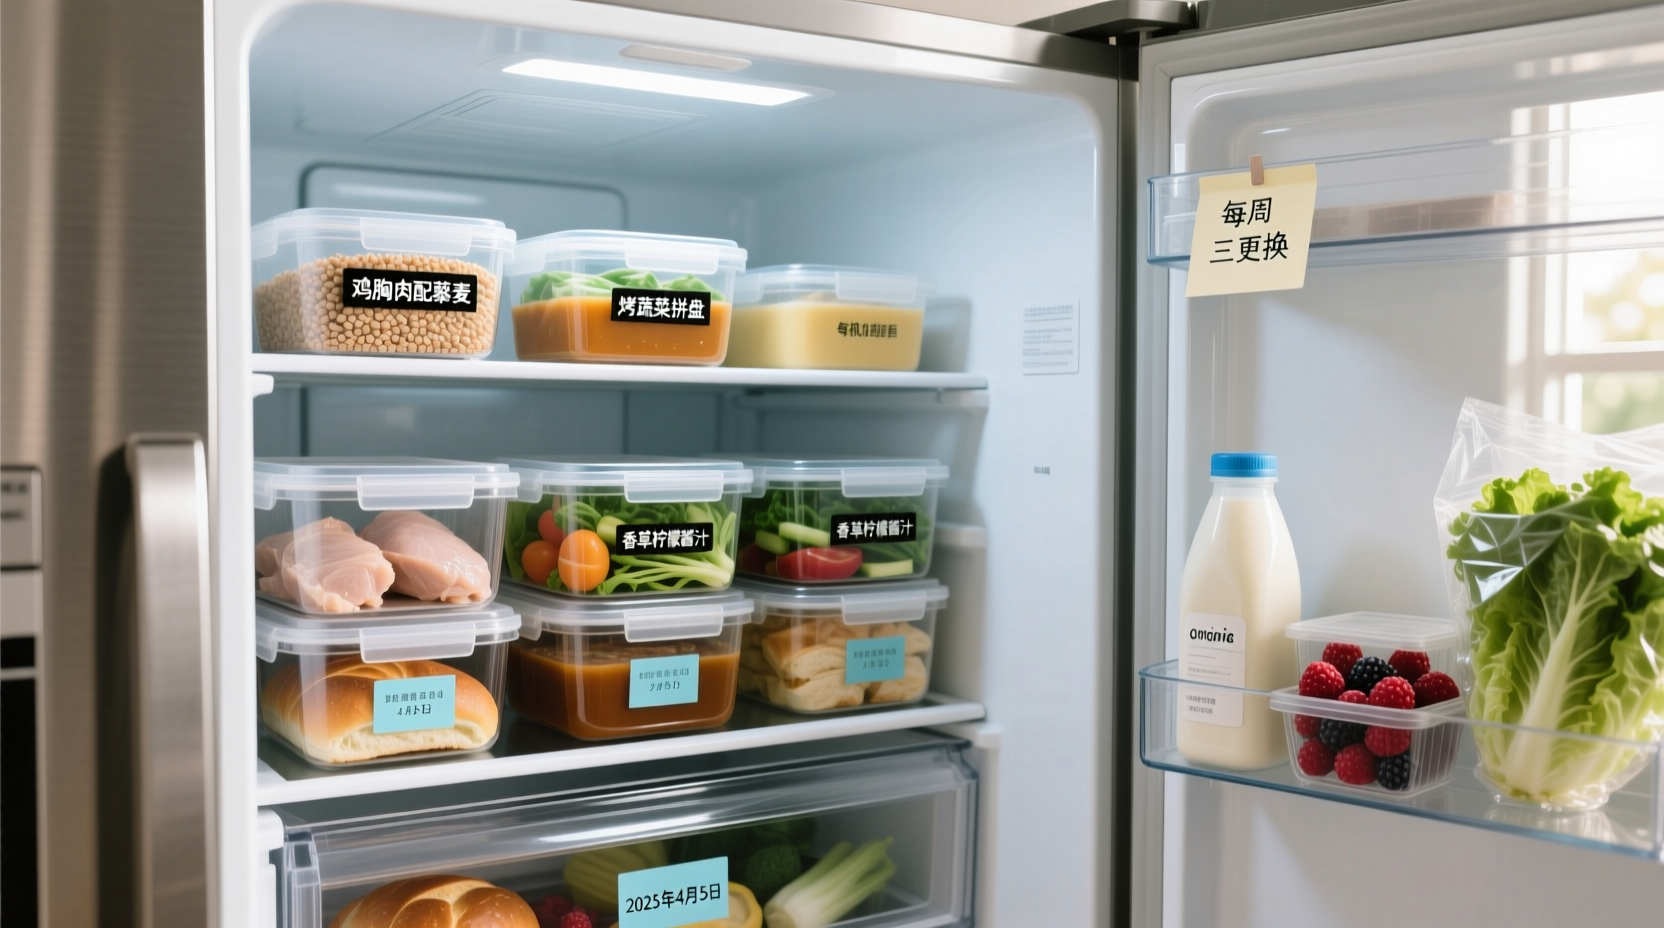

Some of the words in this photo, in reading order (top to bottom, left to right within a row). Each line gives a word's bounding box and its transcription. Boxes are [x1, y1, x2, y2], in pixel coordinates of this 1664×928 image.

[1221, 196, 1272, 228] 每周
[1209, 230, 1289, 263] 三更换
[617, 295, 705, 319] 烤蔬菜拼盘
[625, 882, 721, 914] 2025年4月5日
